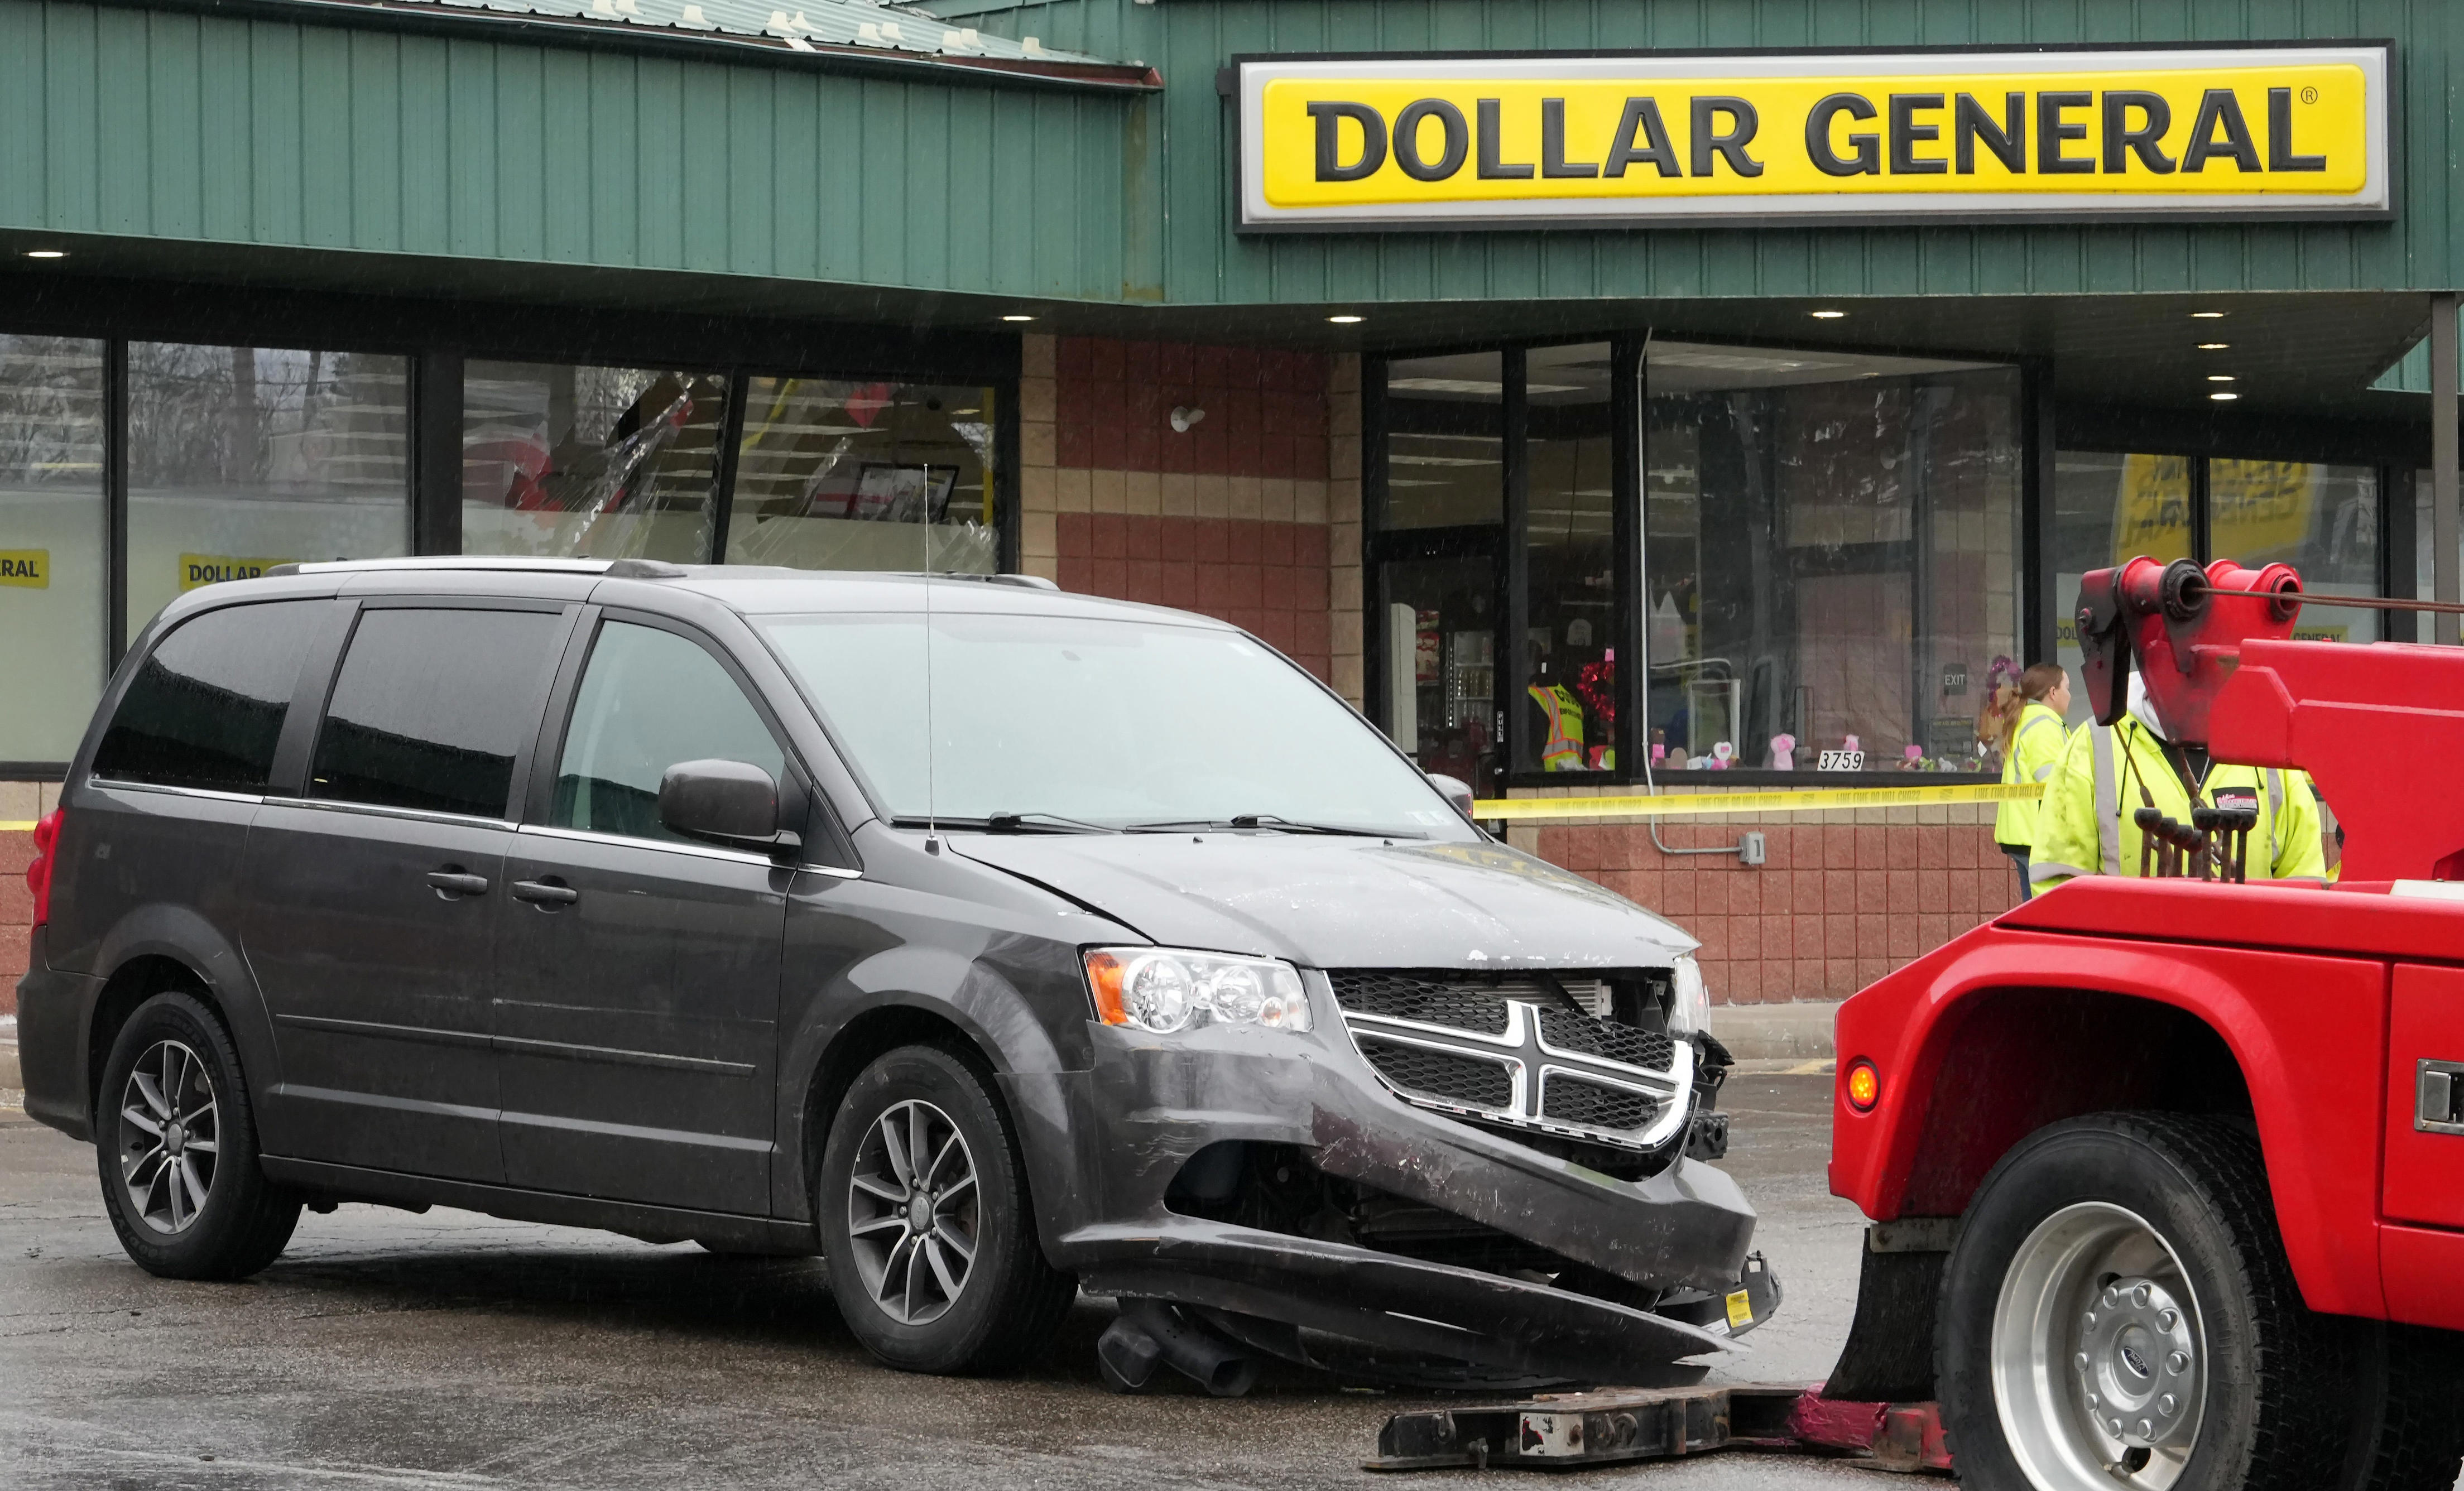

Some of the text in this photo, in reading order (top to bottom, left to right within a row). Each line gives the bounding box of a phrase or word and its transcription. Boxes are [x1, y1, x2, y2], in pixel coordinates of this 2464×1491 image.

[1307, 95, 1764, 182] DOLLAR
[1805, 88, 2326, 177] GENERAL
[0, 559, 39, 578] RAL
[1944, 674, 1966, 686] EXIT
[1820, 752, 1862, 769] 3759
